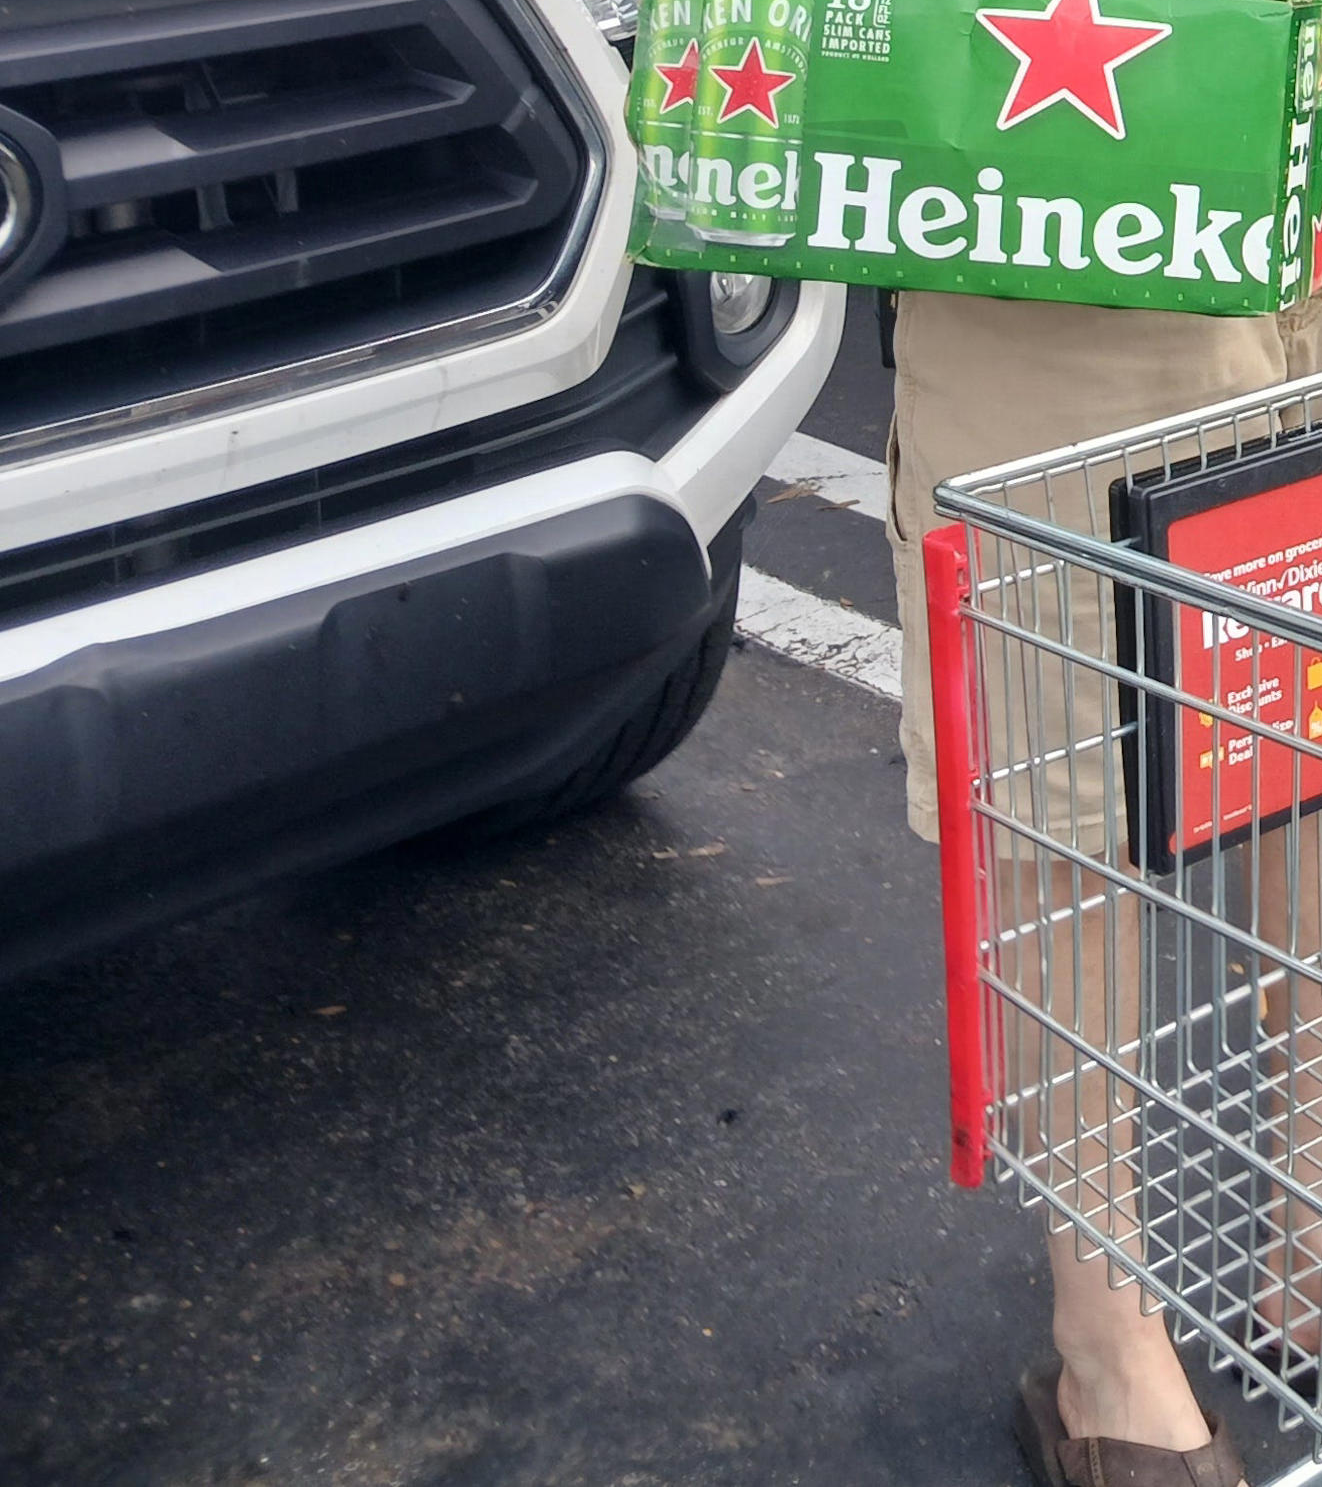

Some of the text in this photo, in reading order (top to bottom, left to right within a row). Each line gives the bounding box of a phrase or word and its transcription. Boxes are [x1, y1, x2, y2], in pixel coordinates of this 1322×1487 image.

[825, 10, 865, 26] PACK
[823, 24, 891, 41] SLIM CANS
[822, 36, 890, 54] IMPORTED
[1233, 556, 1266, 577] more
[1268, 550, 1284, 565] on
[1228, 747, 1254, 765] Deal
